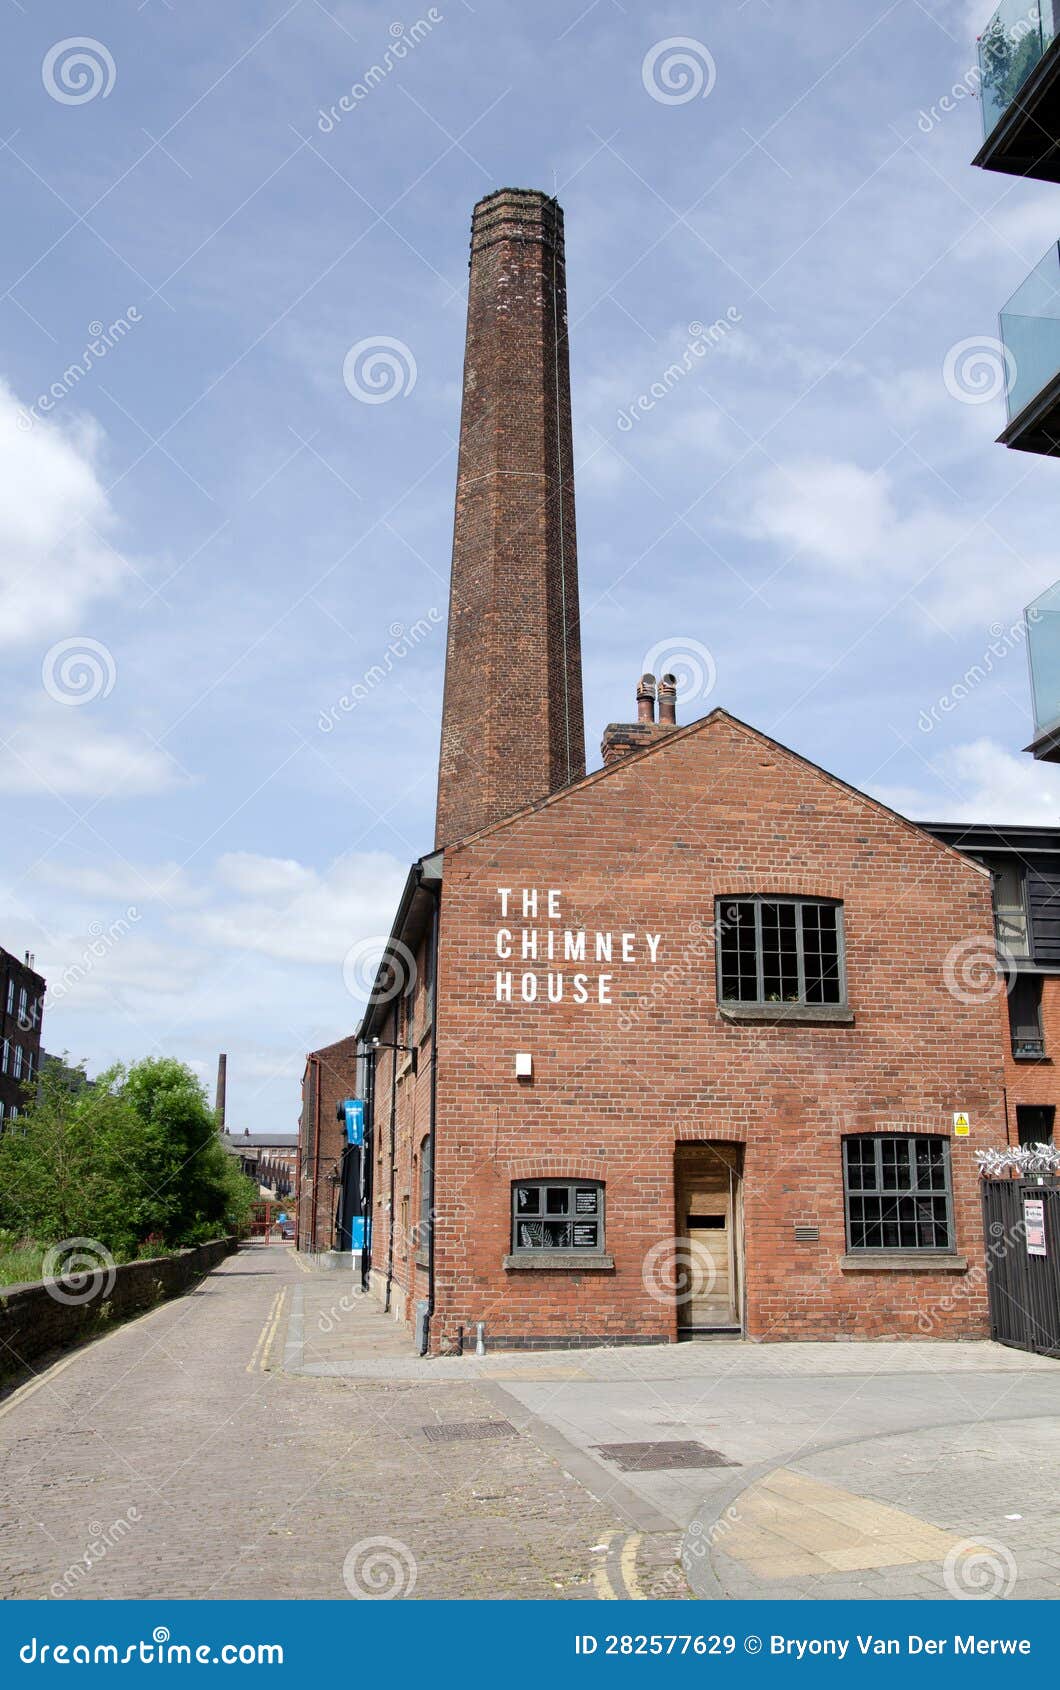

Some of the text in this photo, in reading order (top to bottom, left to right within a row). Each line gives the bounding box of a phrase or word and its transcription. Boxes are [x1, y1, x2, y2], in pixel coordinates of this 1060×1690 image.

[497, 888, 562, 918] THE
[496, 928, 662, 963] CHIMNEY
[496, 971, 613, 1004] HOUSE
